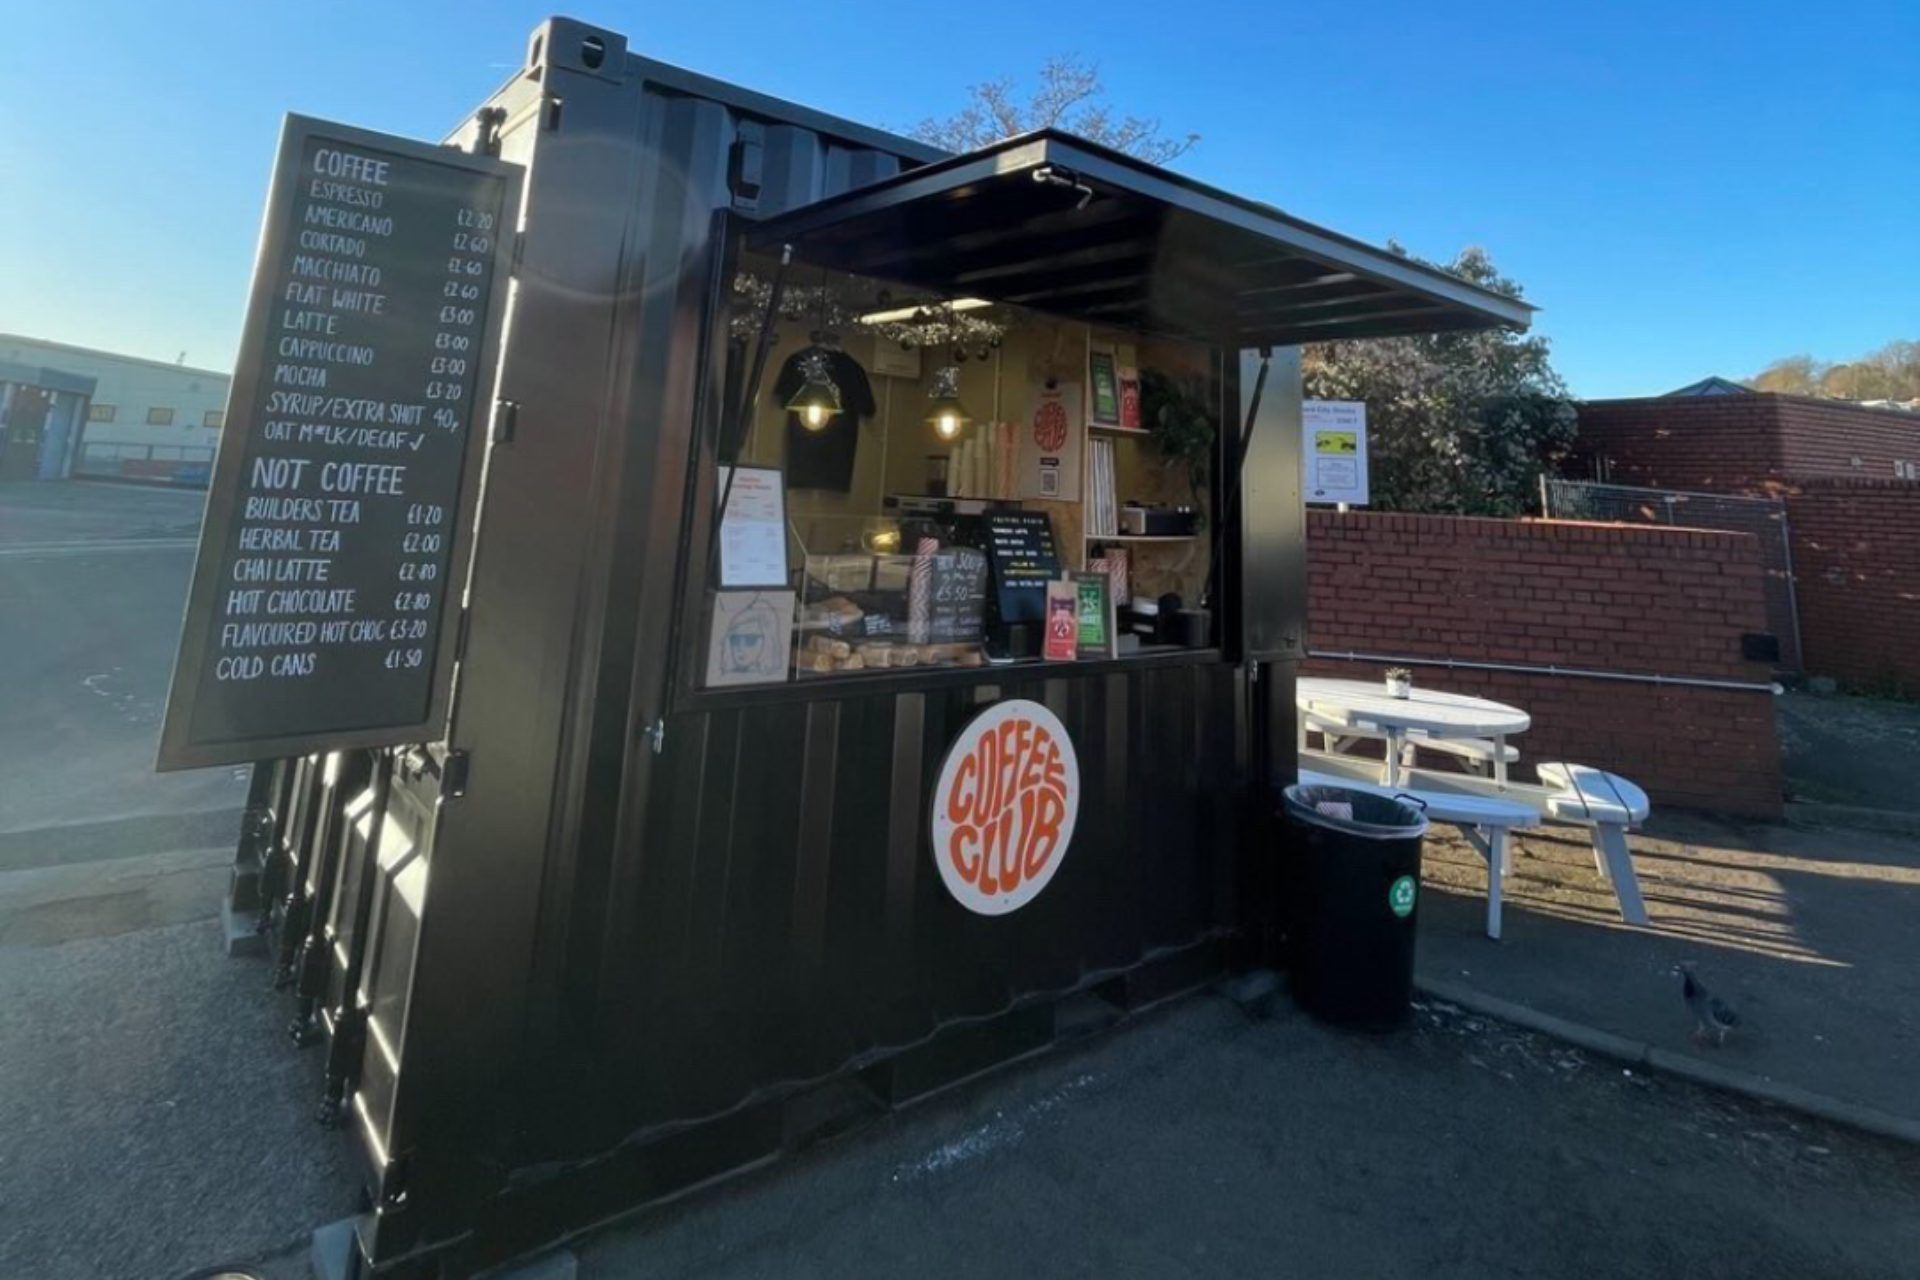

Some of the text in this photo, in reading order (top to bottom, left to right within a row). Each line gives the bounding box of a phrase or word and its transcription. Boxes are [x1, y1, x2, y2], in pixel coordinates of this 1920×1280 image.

[313, 149, 390, 186] COFFEE
[310, 179, 383, 209] ESPRESSO
[304, 204, 393, 236] AMERICANO
[300, 230, 365, 257] CORTADO
[292, 255, 381, 287] MACCHIATO
[285, 282, 328, 305] FLAT
[332, 288, 386, 314] WHITE
[283, 309, 339, 335] LATTE
[278, 336, 374, 366] CAPPUCCINO
[274, 364, 326, 388] MOCHA
[266, 391, 385, 422] SYRUP/EXTRA
[388, 403, 426, 426] SHOT
[264, 421, 298, 441] OAT
[251, 456, 407, 495] NOT COFFEE
[245, 497, 324, 521] BUILDERS
[327, 500, 360, 523] TEA
[239, 528, 304, 550] HERBAL
[309, 530, 340, 552] TEA
[234, 558, 272, 582] CHAI
[275, 559, 331, 581] LATTE
[227, 590, 265, 615] HOT
[267, 589, 356, 615] CHOCOLATE
[221, 622, 317, 648] FLAVOURED
[320, 621, 350, 643] HOT
[350, 620, 386, 642] CHOC
[216, 656, 264, 681] COLD
[271, 652, 317, 676] CANS
[947, 719, 1067, 828] COFFEE
[949, 786, 1065, 896] CLUB
